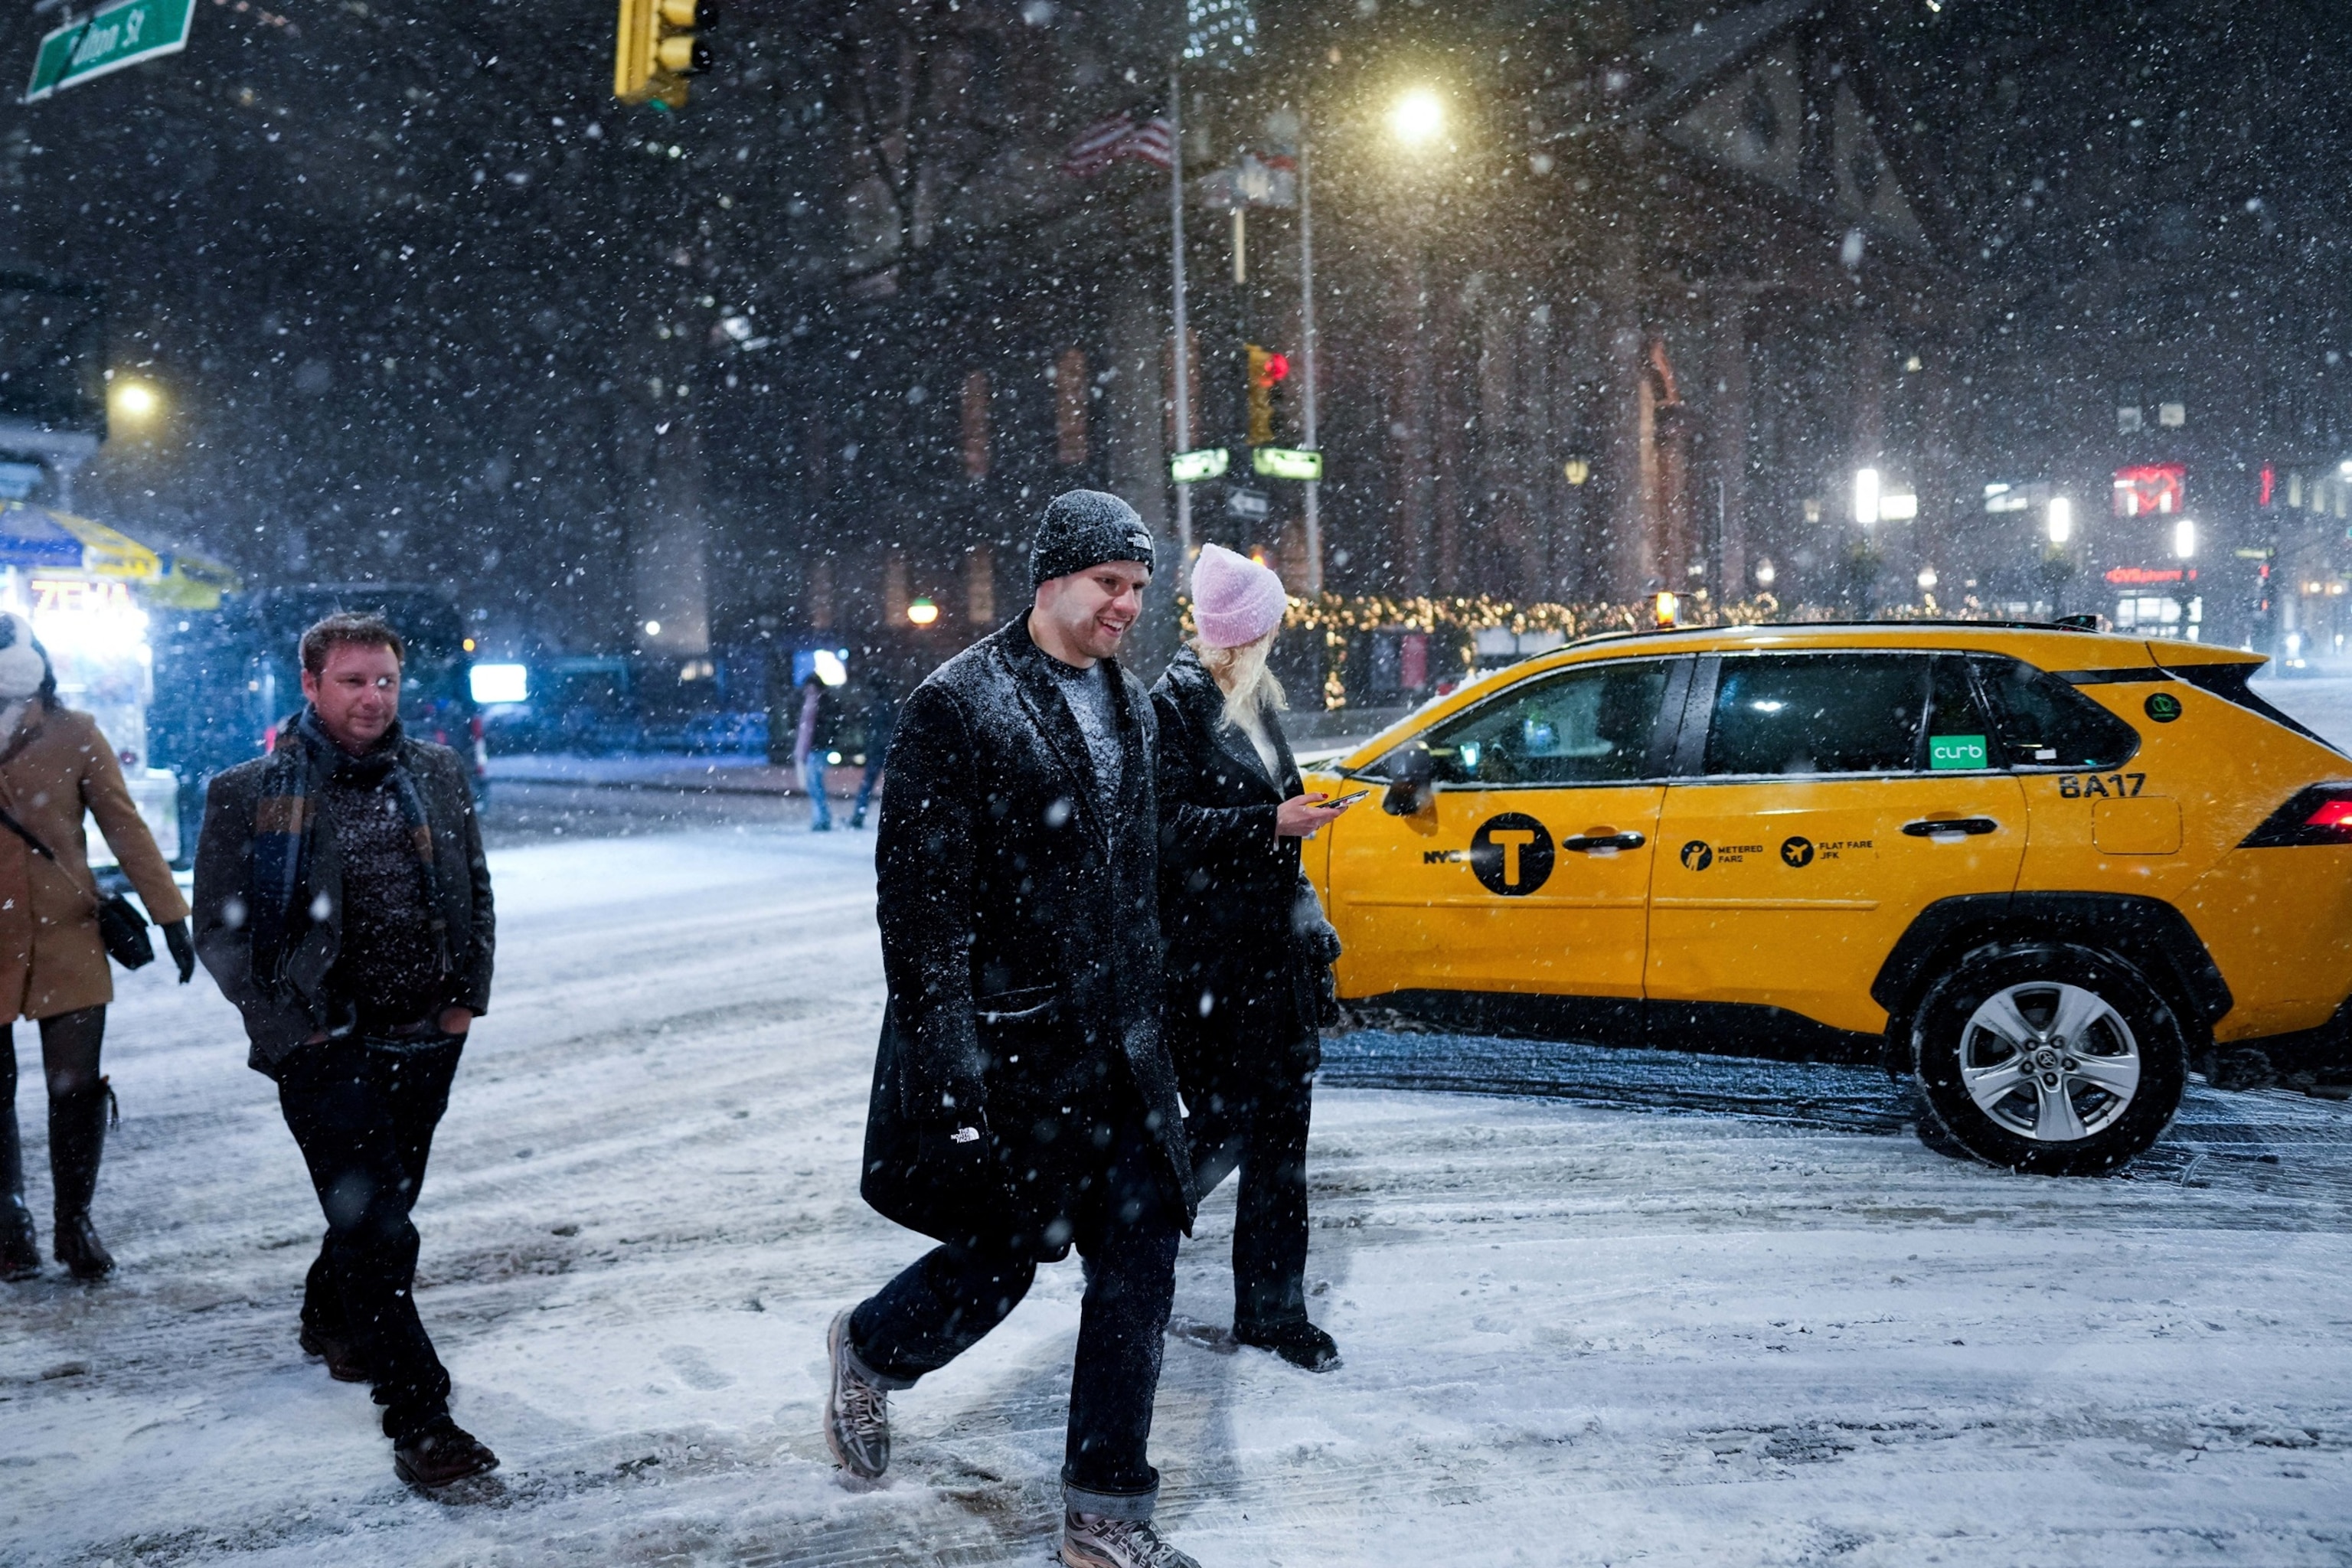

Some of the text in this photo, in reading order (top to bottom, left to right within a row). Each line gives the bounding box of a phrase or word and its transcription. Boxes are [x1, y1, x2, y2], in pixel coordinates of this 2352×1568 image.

[1935, 744, 1983, 759] curb
[1718, 845, 1762, 854] METERED
[1819, 841, 1843, 850] FLAT
[1424, 830, 1534, 885] NYC T
